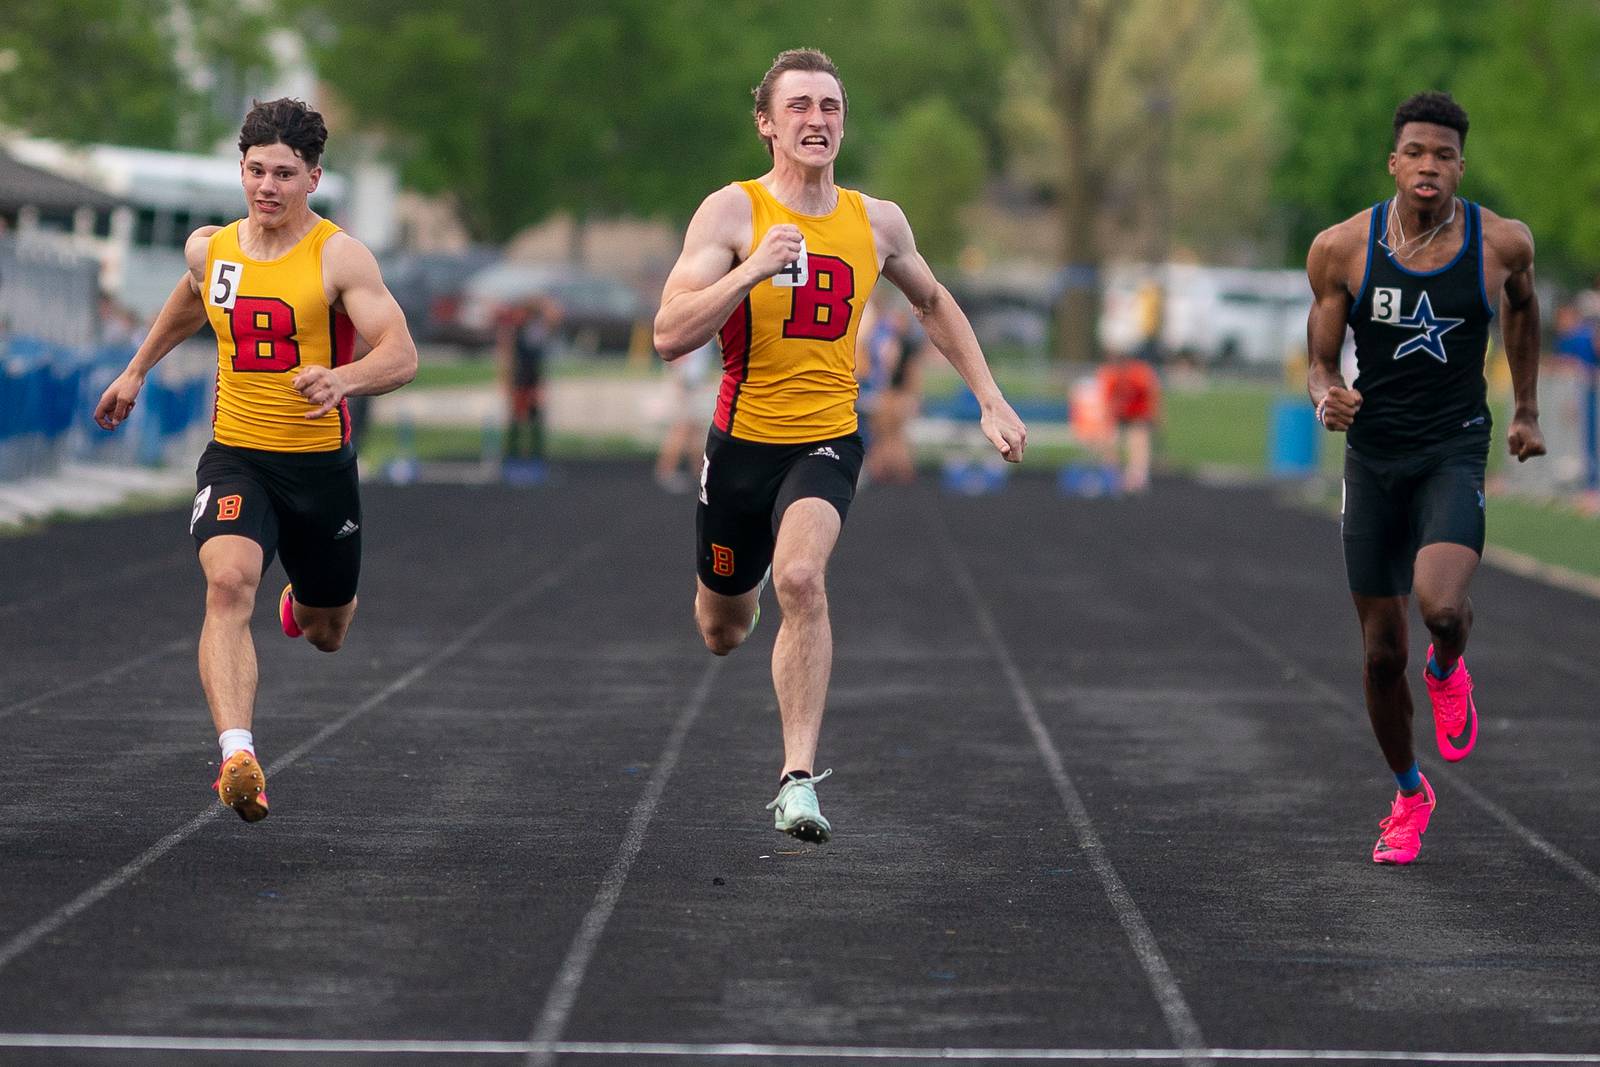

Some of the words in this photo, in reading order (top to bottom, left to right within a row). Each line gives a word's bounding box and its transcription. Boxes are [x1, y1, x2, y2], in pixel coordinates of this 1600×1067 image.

[214, 263, 236, 304] 5
[782, 252, 855, 342] B
[1377, 289, 1393, 320] 3
[223, 295, 301, 373] B
[216, 494, 242, 520] B
[712, 543, 734, 577] B
